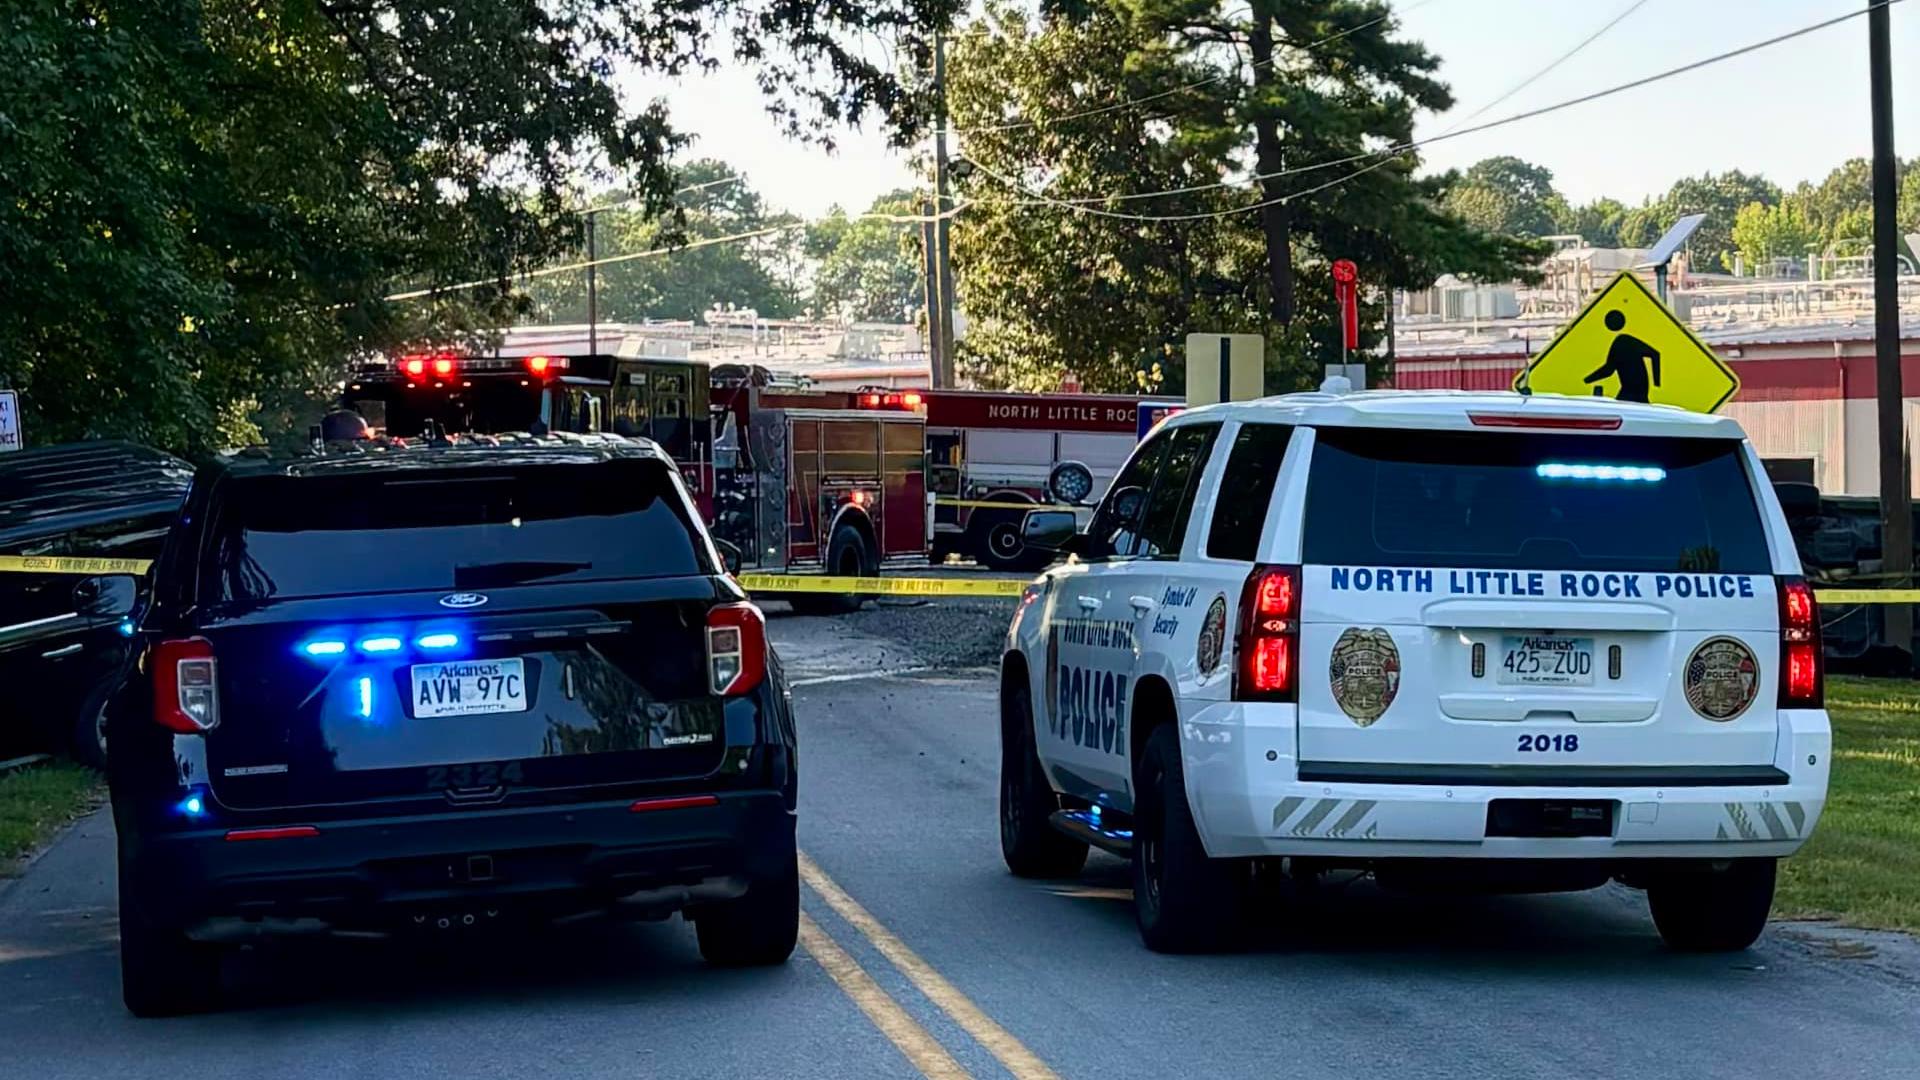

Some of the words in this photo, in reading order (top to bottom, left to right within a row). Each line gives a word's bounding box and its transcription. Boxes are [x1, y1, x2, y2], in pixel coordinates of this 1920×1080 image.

[988, 405, 1040, 419] NORTH
[1048, 407, 1098, 421] LITTLE
[1106, 409, 1136, 422] ROC
[1331, 568, 1433, 593] NORTH
[1449, 571, 1544, 596] LITTLE
[1560, 573, 1642, 597] ROCK
[1655, 575, 1754, 598] POLICE
[1521, 637, 1574, 650] Arkansas
[438, 663, 499, 678] Arkansas
[1348, 667, 1382, 675] POLICE
[1503, 650, 1540, 673] 425
[1553, 651, 1591, 675] ZUD
[1706, 670, 1738, 678] POLICE
[419, 678, 461, 705] AVW
[477, 674, 520, 701] 97C
[1060, 664, 1127, 757] POLICE
[1517, 734, 1579, 752] 2018
